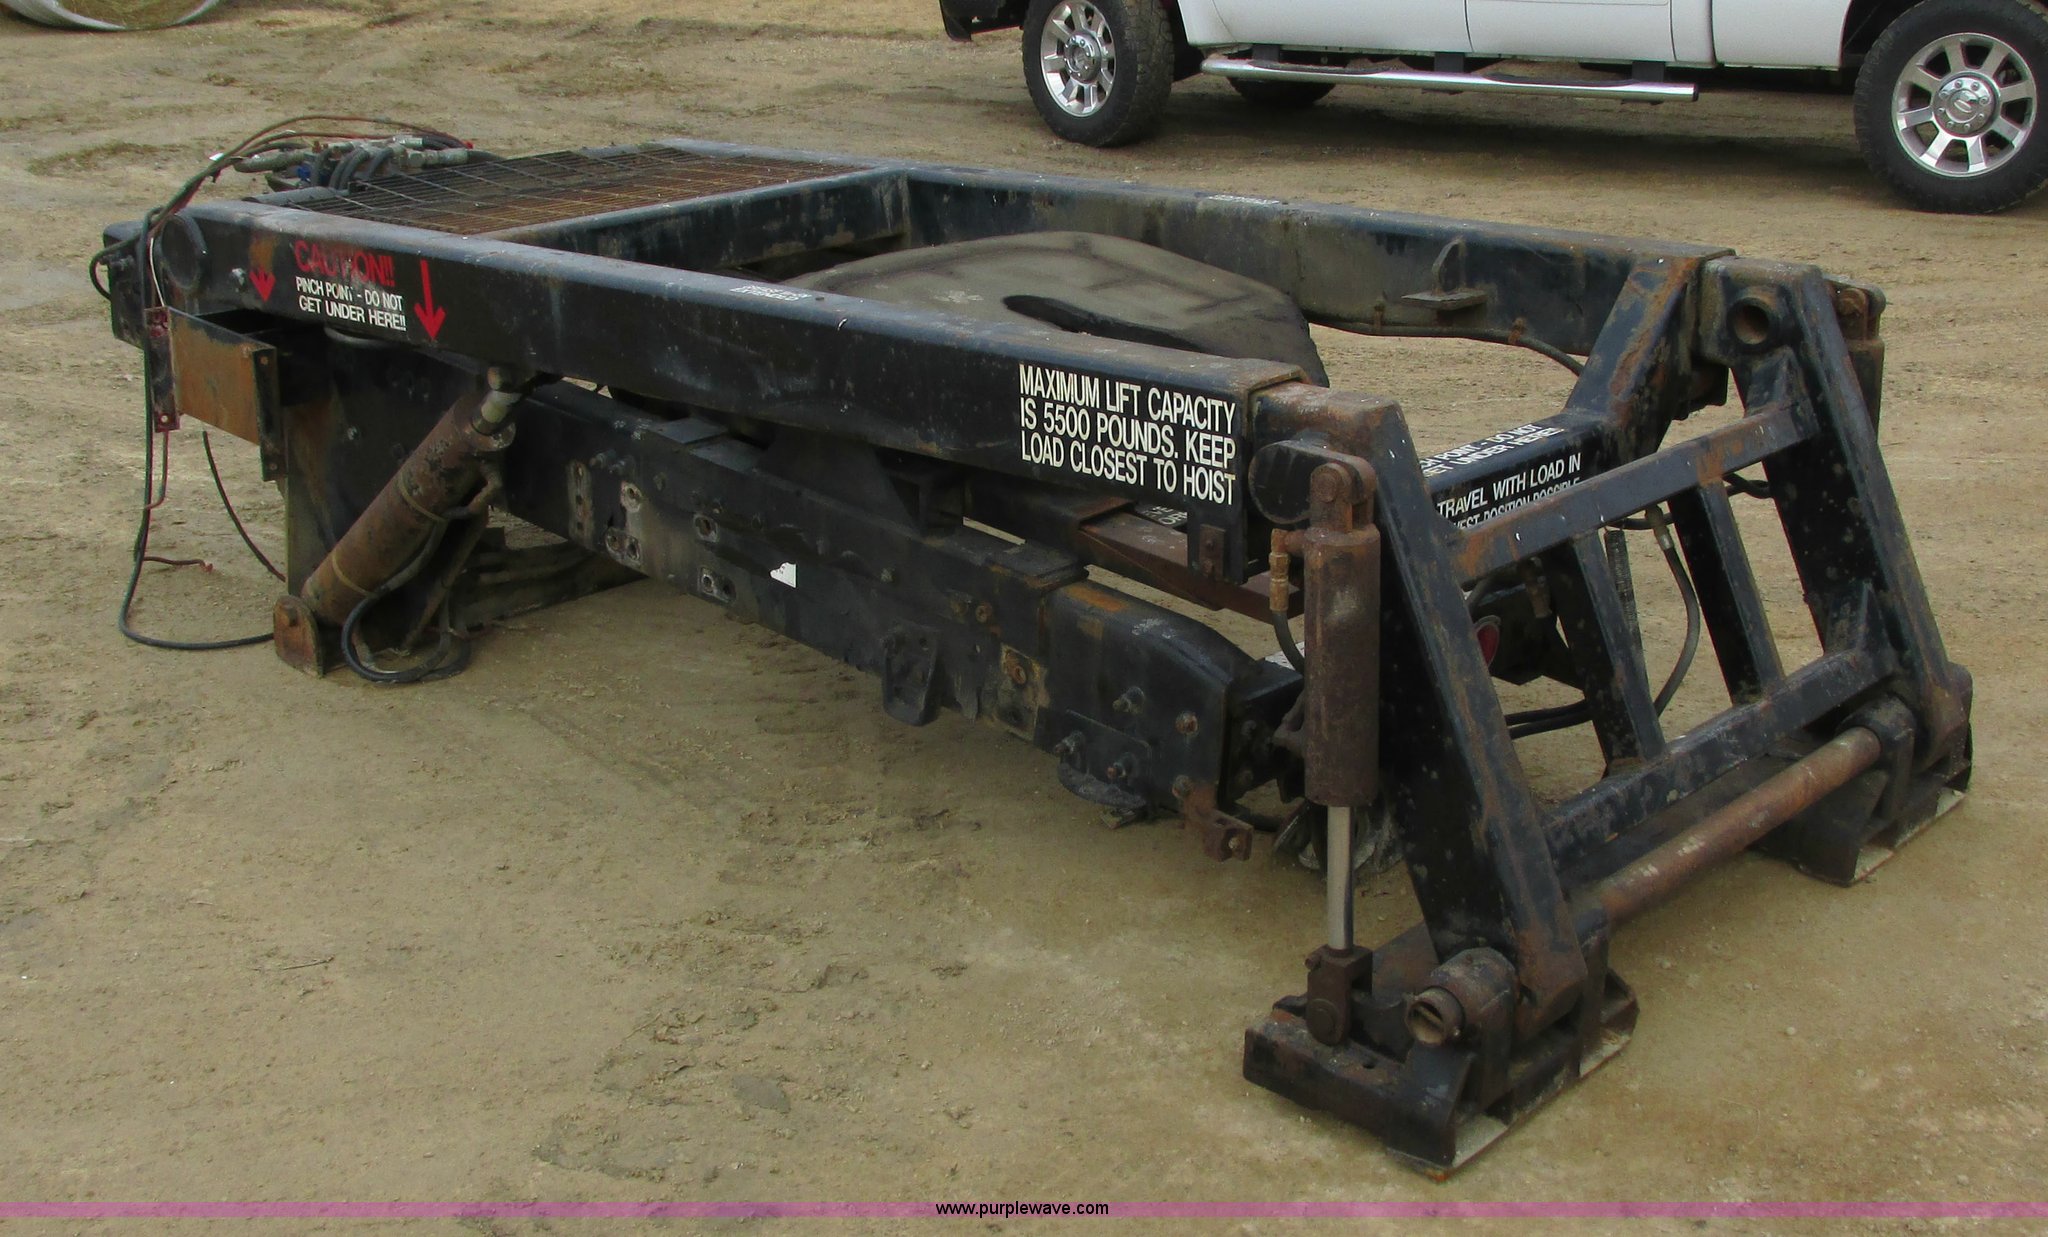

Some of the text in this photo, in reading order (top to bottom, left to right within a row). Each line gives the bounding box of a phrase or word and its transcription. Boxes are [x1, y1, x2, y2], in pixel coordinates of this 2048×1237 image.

[295, 276, 324, 296] PINCH
[325, 281, 353, 301] POINT
[364, 289, 380, 306] DO
[382, 291, 403, 311] NOT
[299, 295, 407, 331] GET UNDER HERE!!
[1019, 363, 1236, 434] MAXIMUM LIFT CAPACITY
[1020, 397, 1236, 469] IS 5500 POUNDS. KEEP
[1450, 444, 1514, 465] UNDER
[1021, 430, 1236, 505] LOAD CLOSEST TO HOIST
[1437, 452, 1581, 518] TRAVEL WITH LOAD IN
